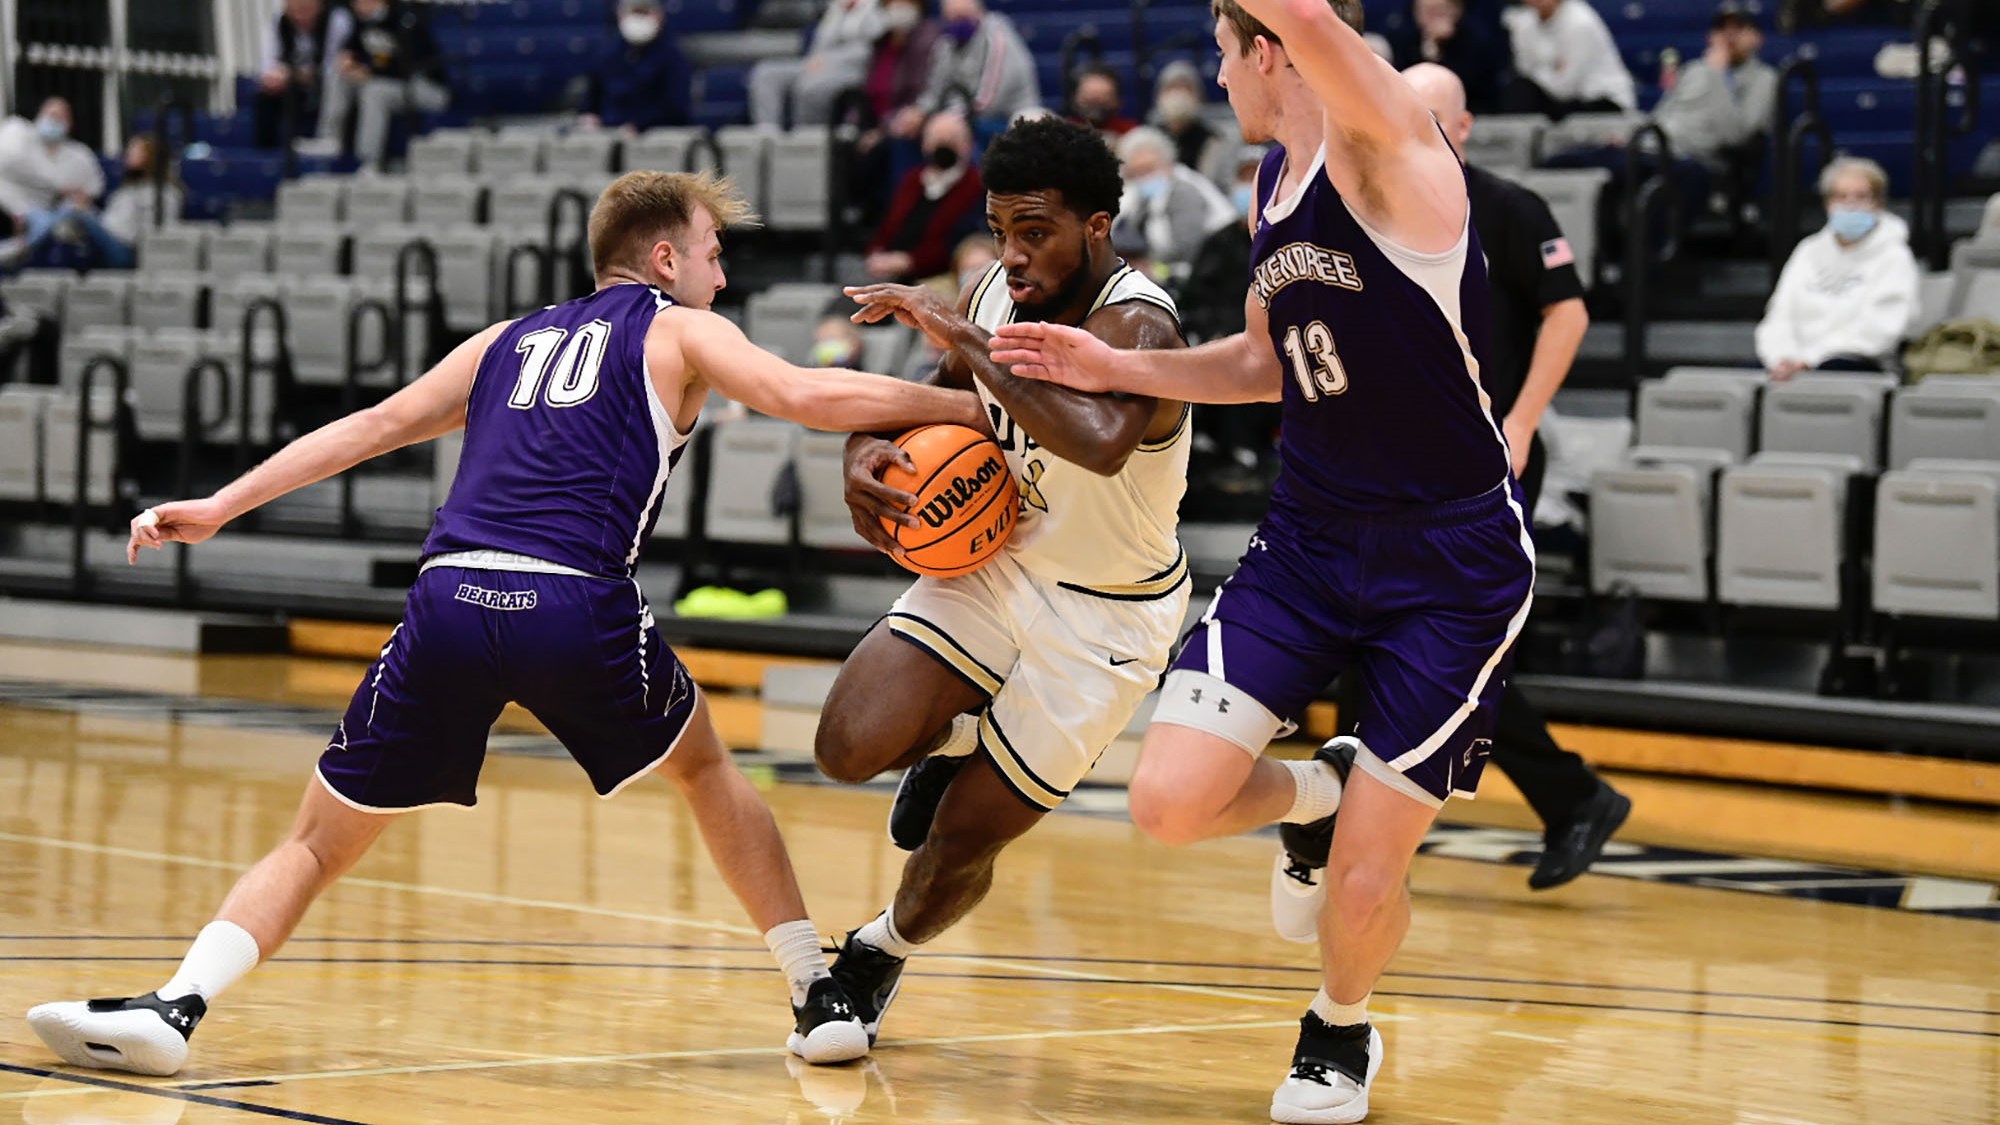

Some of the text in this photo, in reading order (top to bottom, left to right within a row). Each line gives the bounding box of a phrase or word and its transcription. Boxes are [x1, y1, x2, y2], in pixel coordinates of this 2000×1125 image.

[507, 318, 612, 410] 10
[1283, 320, 1349, 403] 13
[917, 456, 1002, 528] Wilson
[455, 584, 537, 610] BEARCATS
